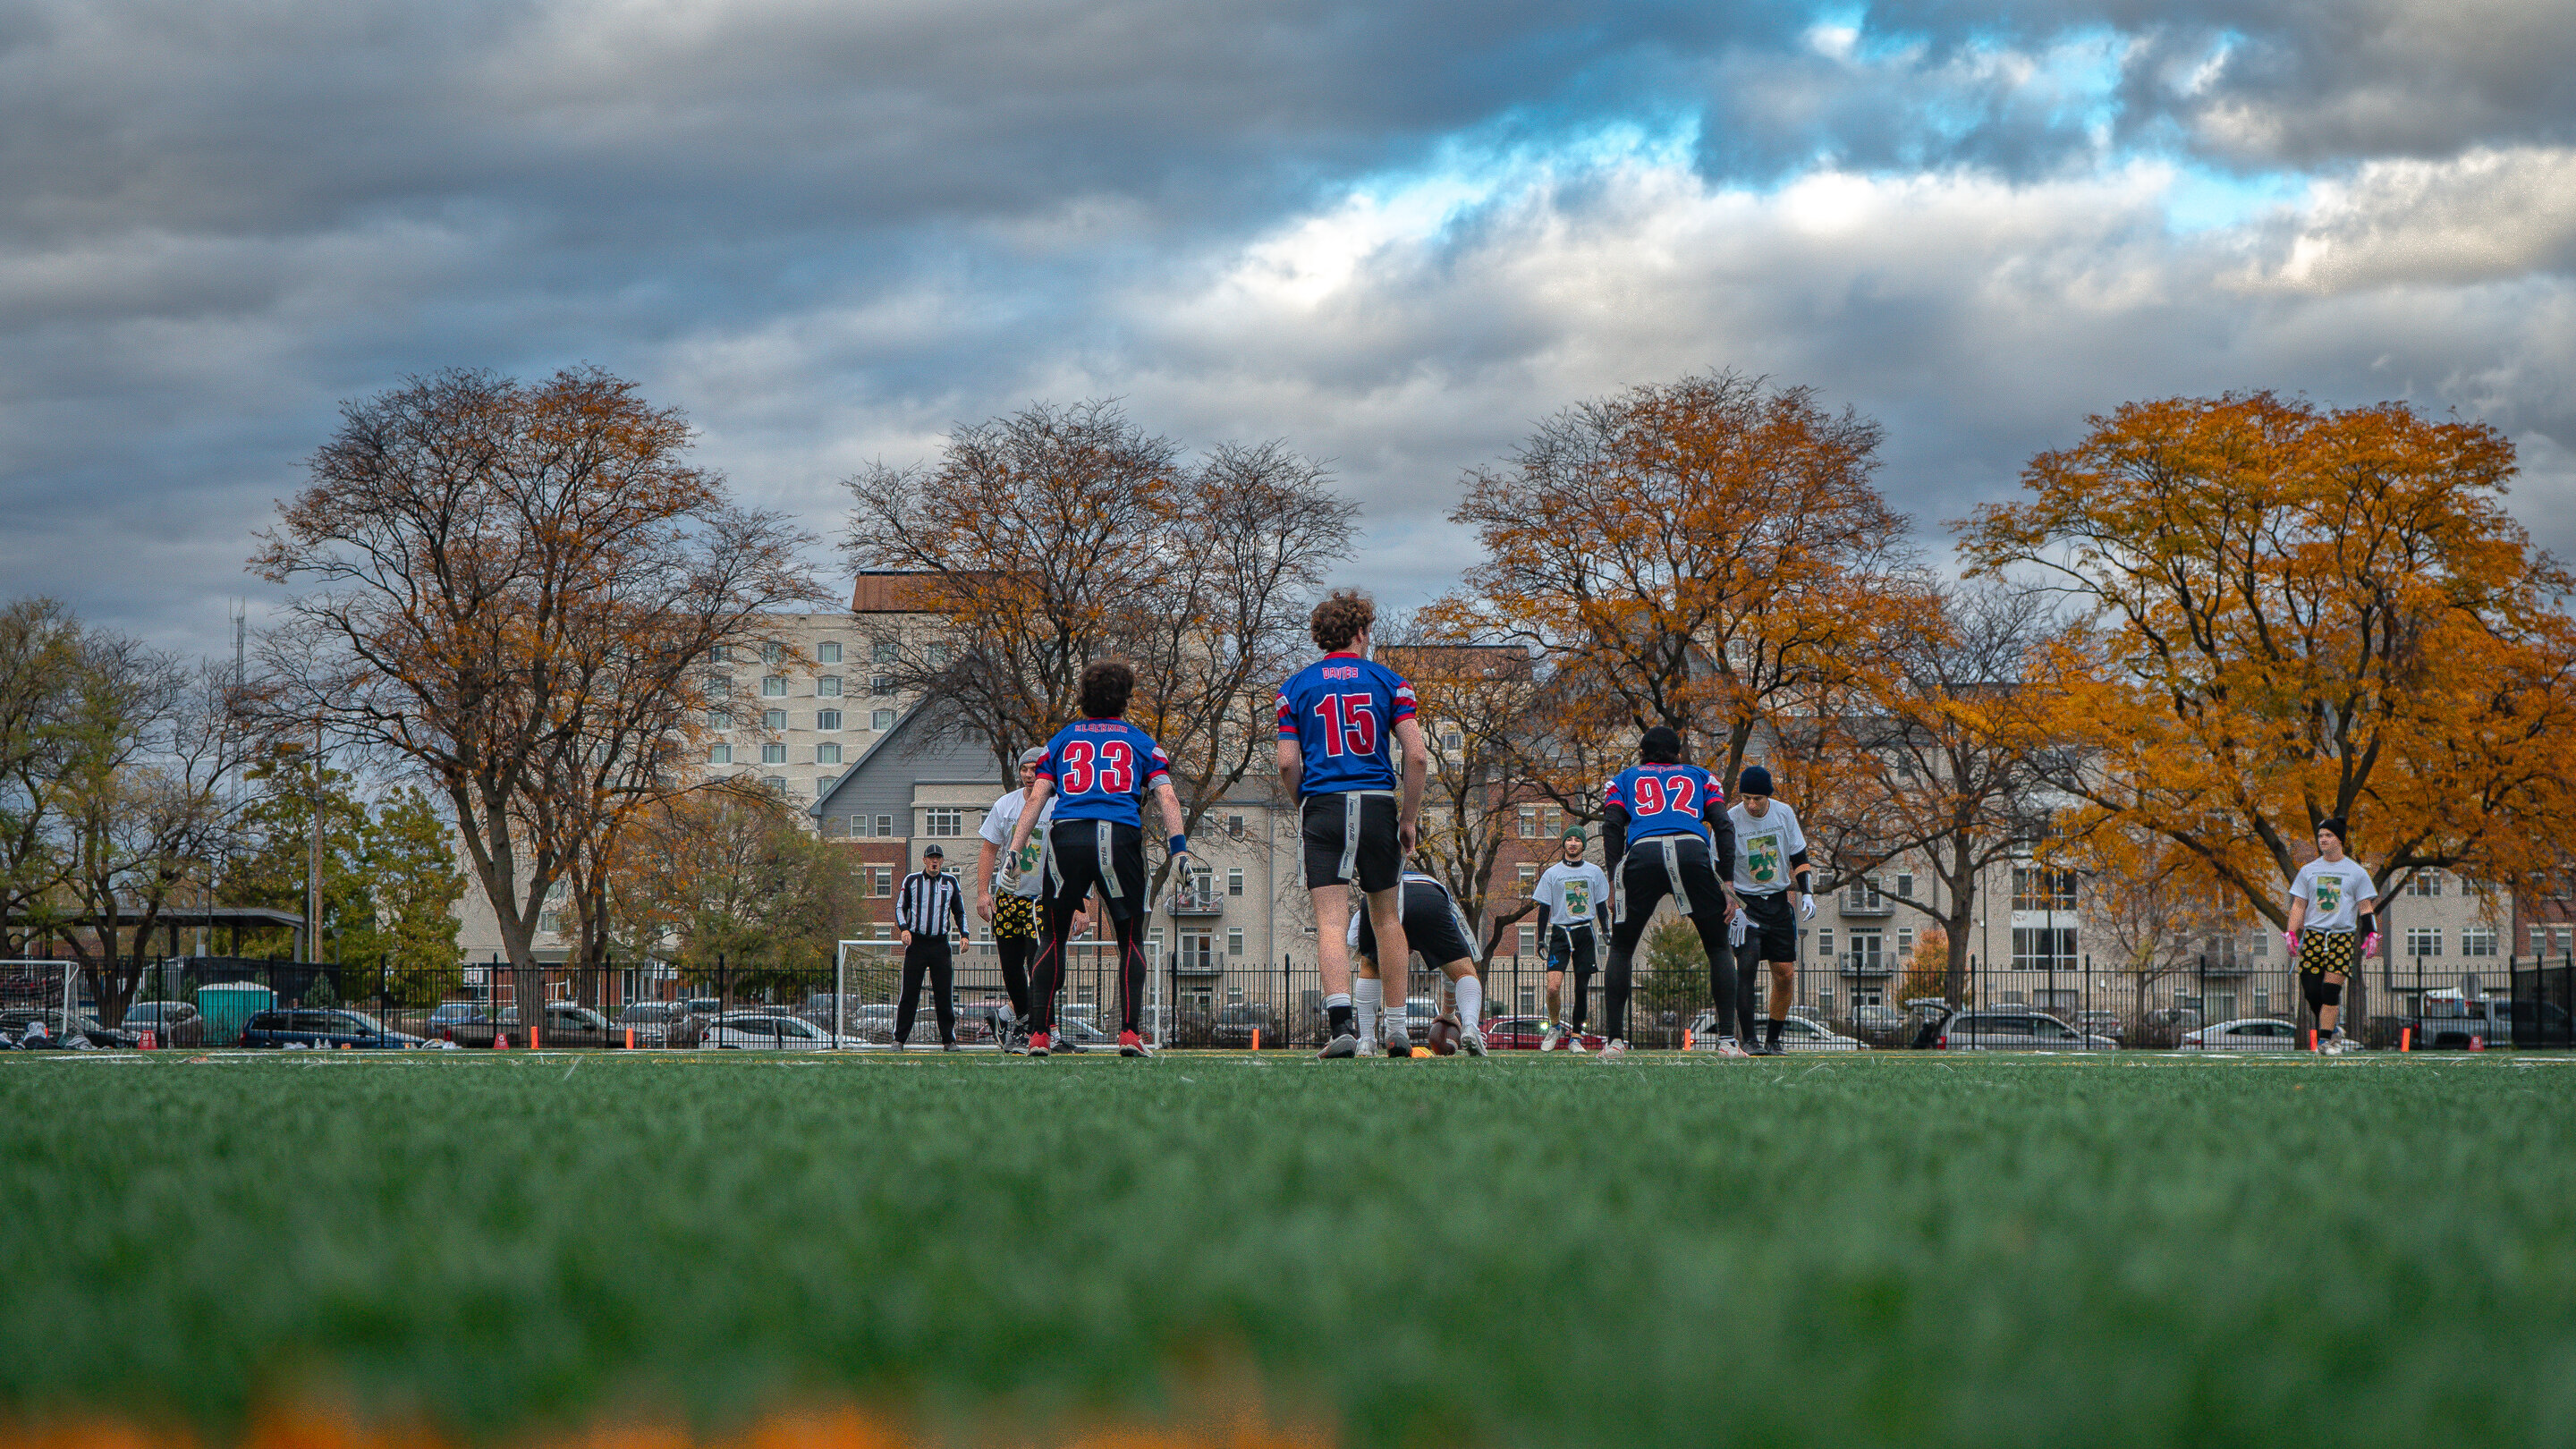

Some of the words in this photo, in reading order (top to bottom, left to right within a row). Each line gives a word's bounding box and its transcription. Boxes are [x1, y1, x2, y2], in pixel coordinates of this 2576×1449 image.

[1322, 665, 1359, 680] DAVIES
[1314, 692, 1377, 758] 15
[1063, 740, 1134, 795] 33
[1634, 775, 1699, 818] 92
